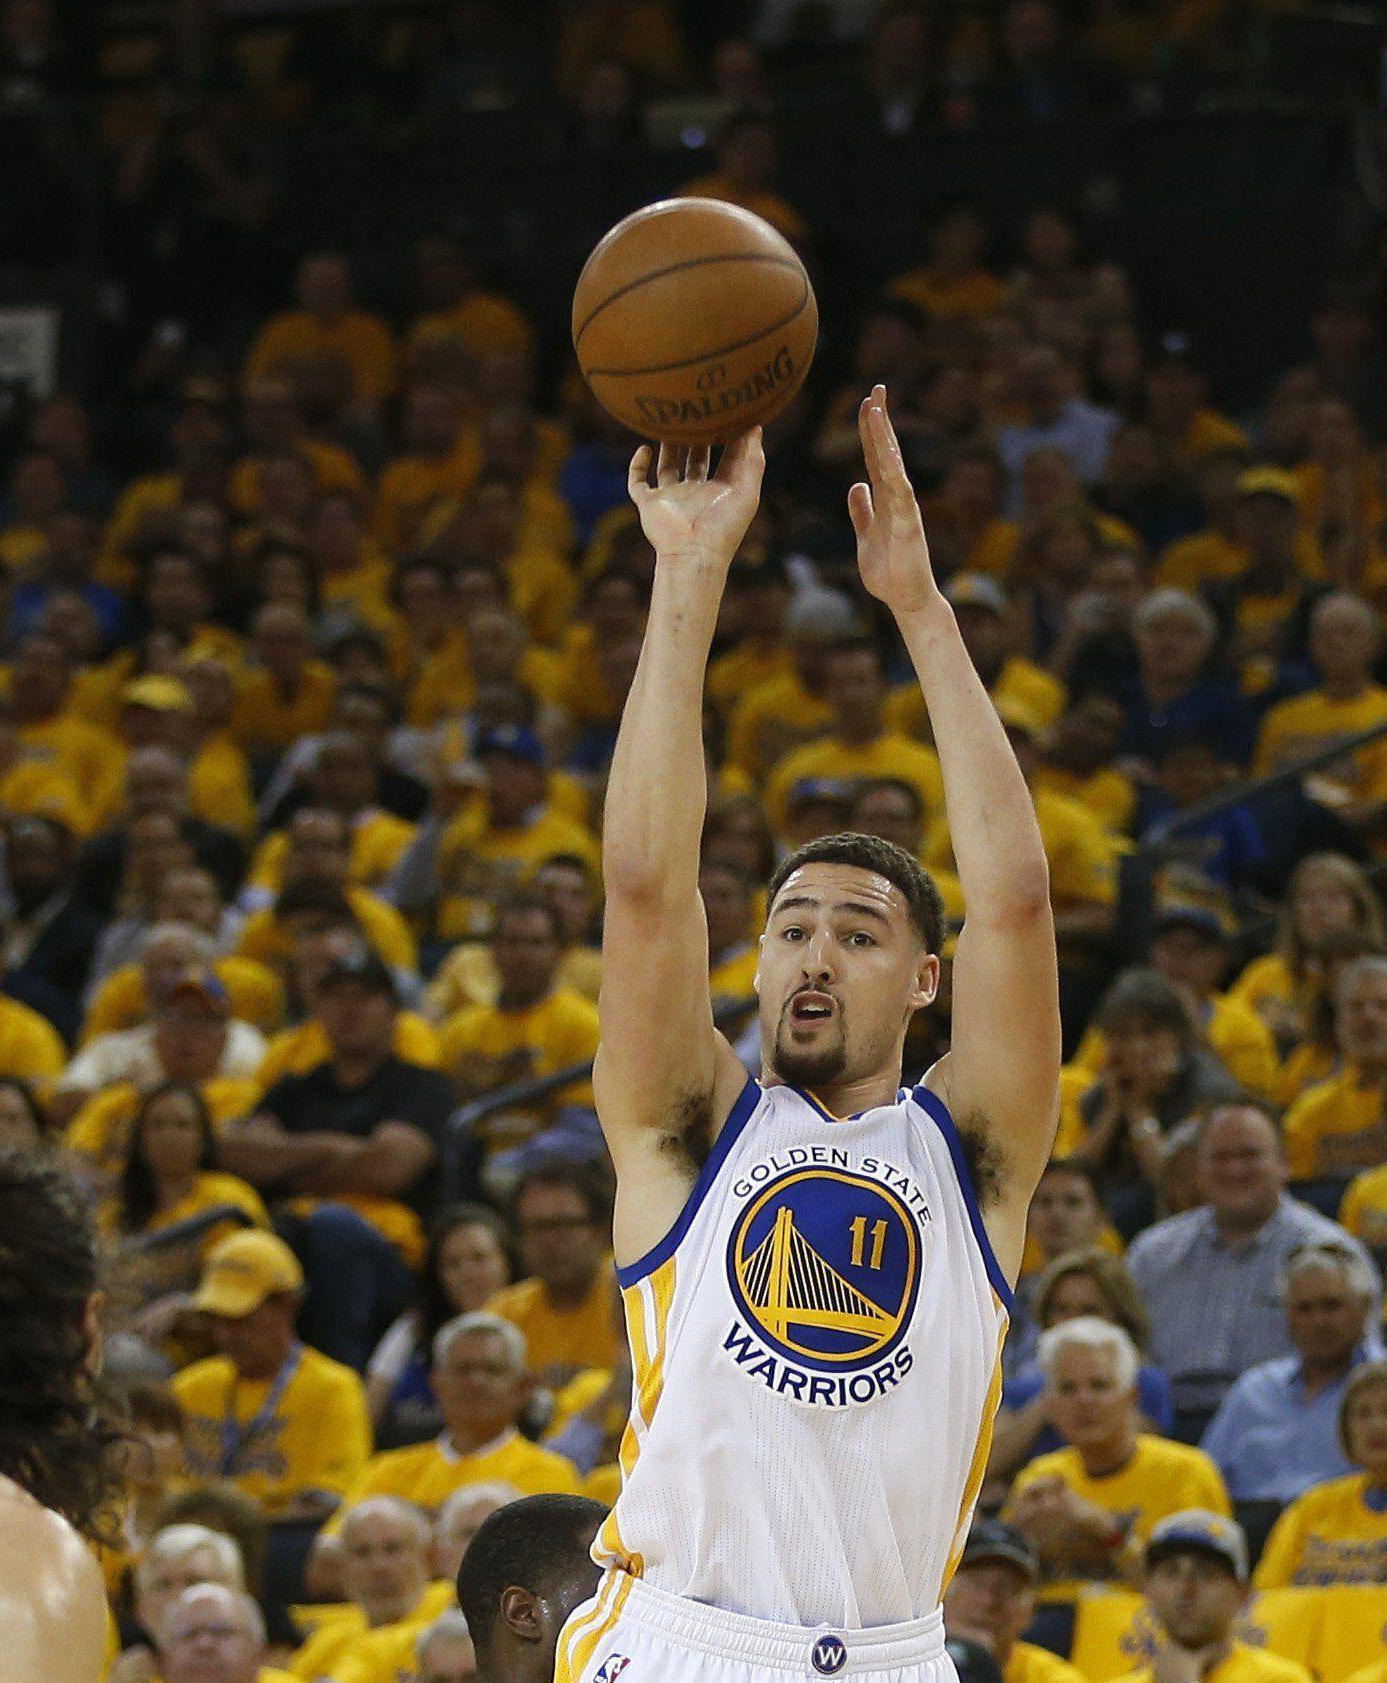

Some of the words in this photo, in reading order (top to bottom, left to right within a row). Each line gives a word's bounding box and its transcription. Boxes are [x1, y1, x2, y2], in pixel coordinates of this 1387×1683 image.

[633, 345, 796, 427] SPALDING
[732, 1144, 850, 1200] GOLDEN
[860, 1156, 933, 1230] STATE
[848, 1214, 889, 1272] 11
[720, 1320, 916, 1409] WARRIORS
[816, 1644, 844, 1668] W
